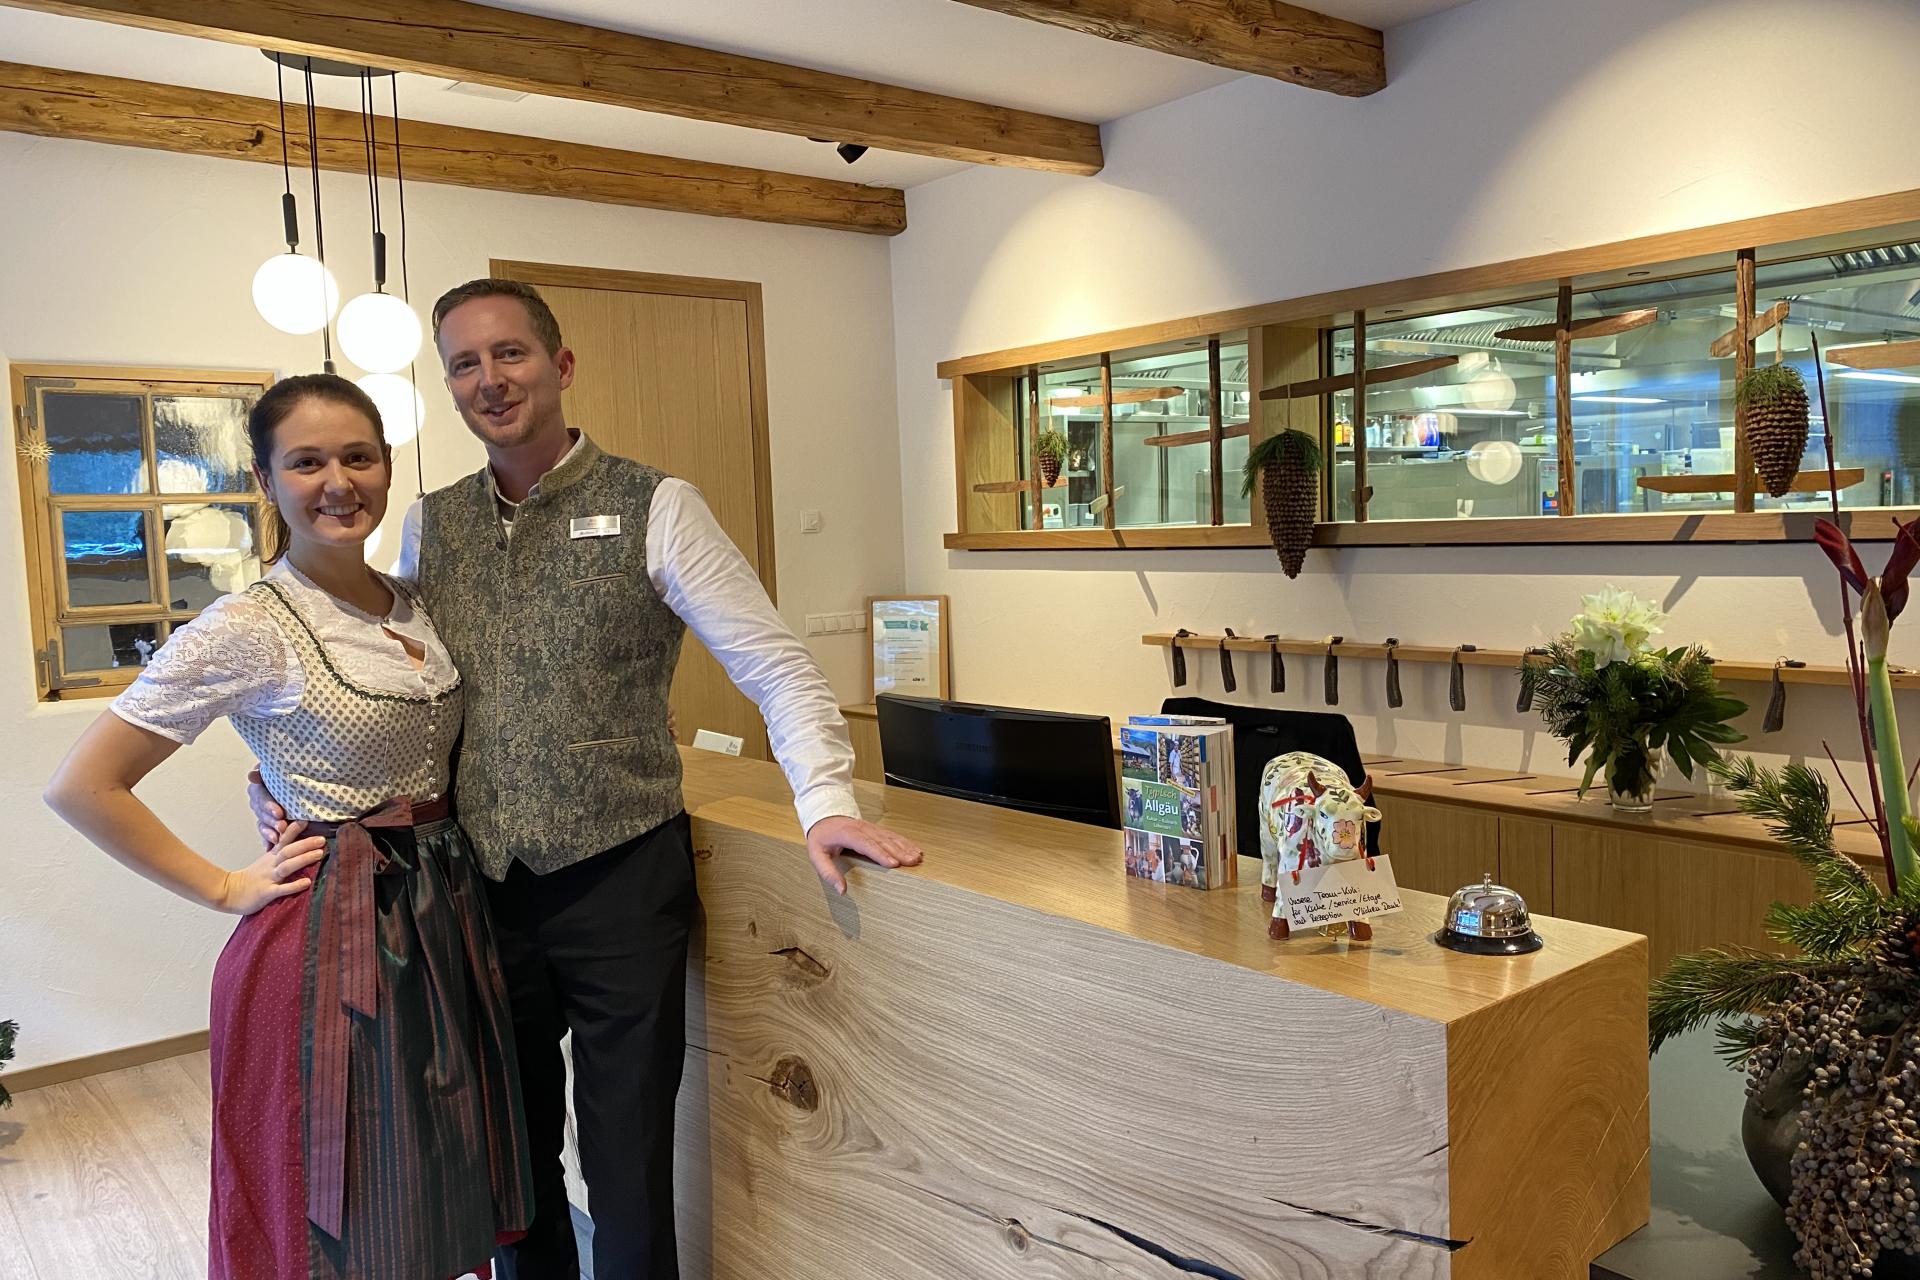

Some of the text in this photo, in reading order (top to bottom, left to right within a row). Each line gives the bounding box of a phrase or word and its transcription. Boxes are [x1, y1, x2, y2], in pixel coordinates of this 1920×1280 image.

[1145, 785, 1177, 799] Typisch
[1145, 799, 1179, 816] Allgäu
[1287, 896, 1313, 906] Unsere
[1293, 917, 1307, 926] und
[1309, 911, 1343, 923] Rezeption
